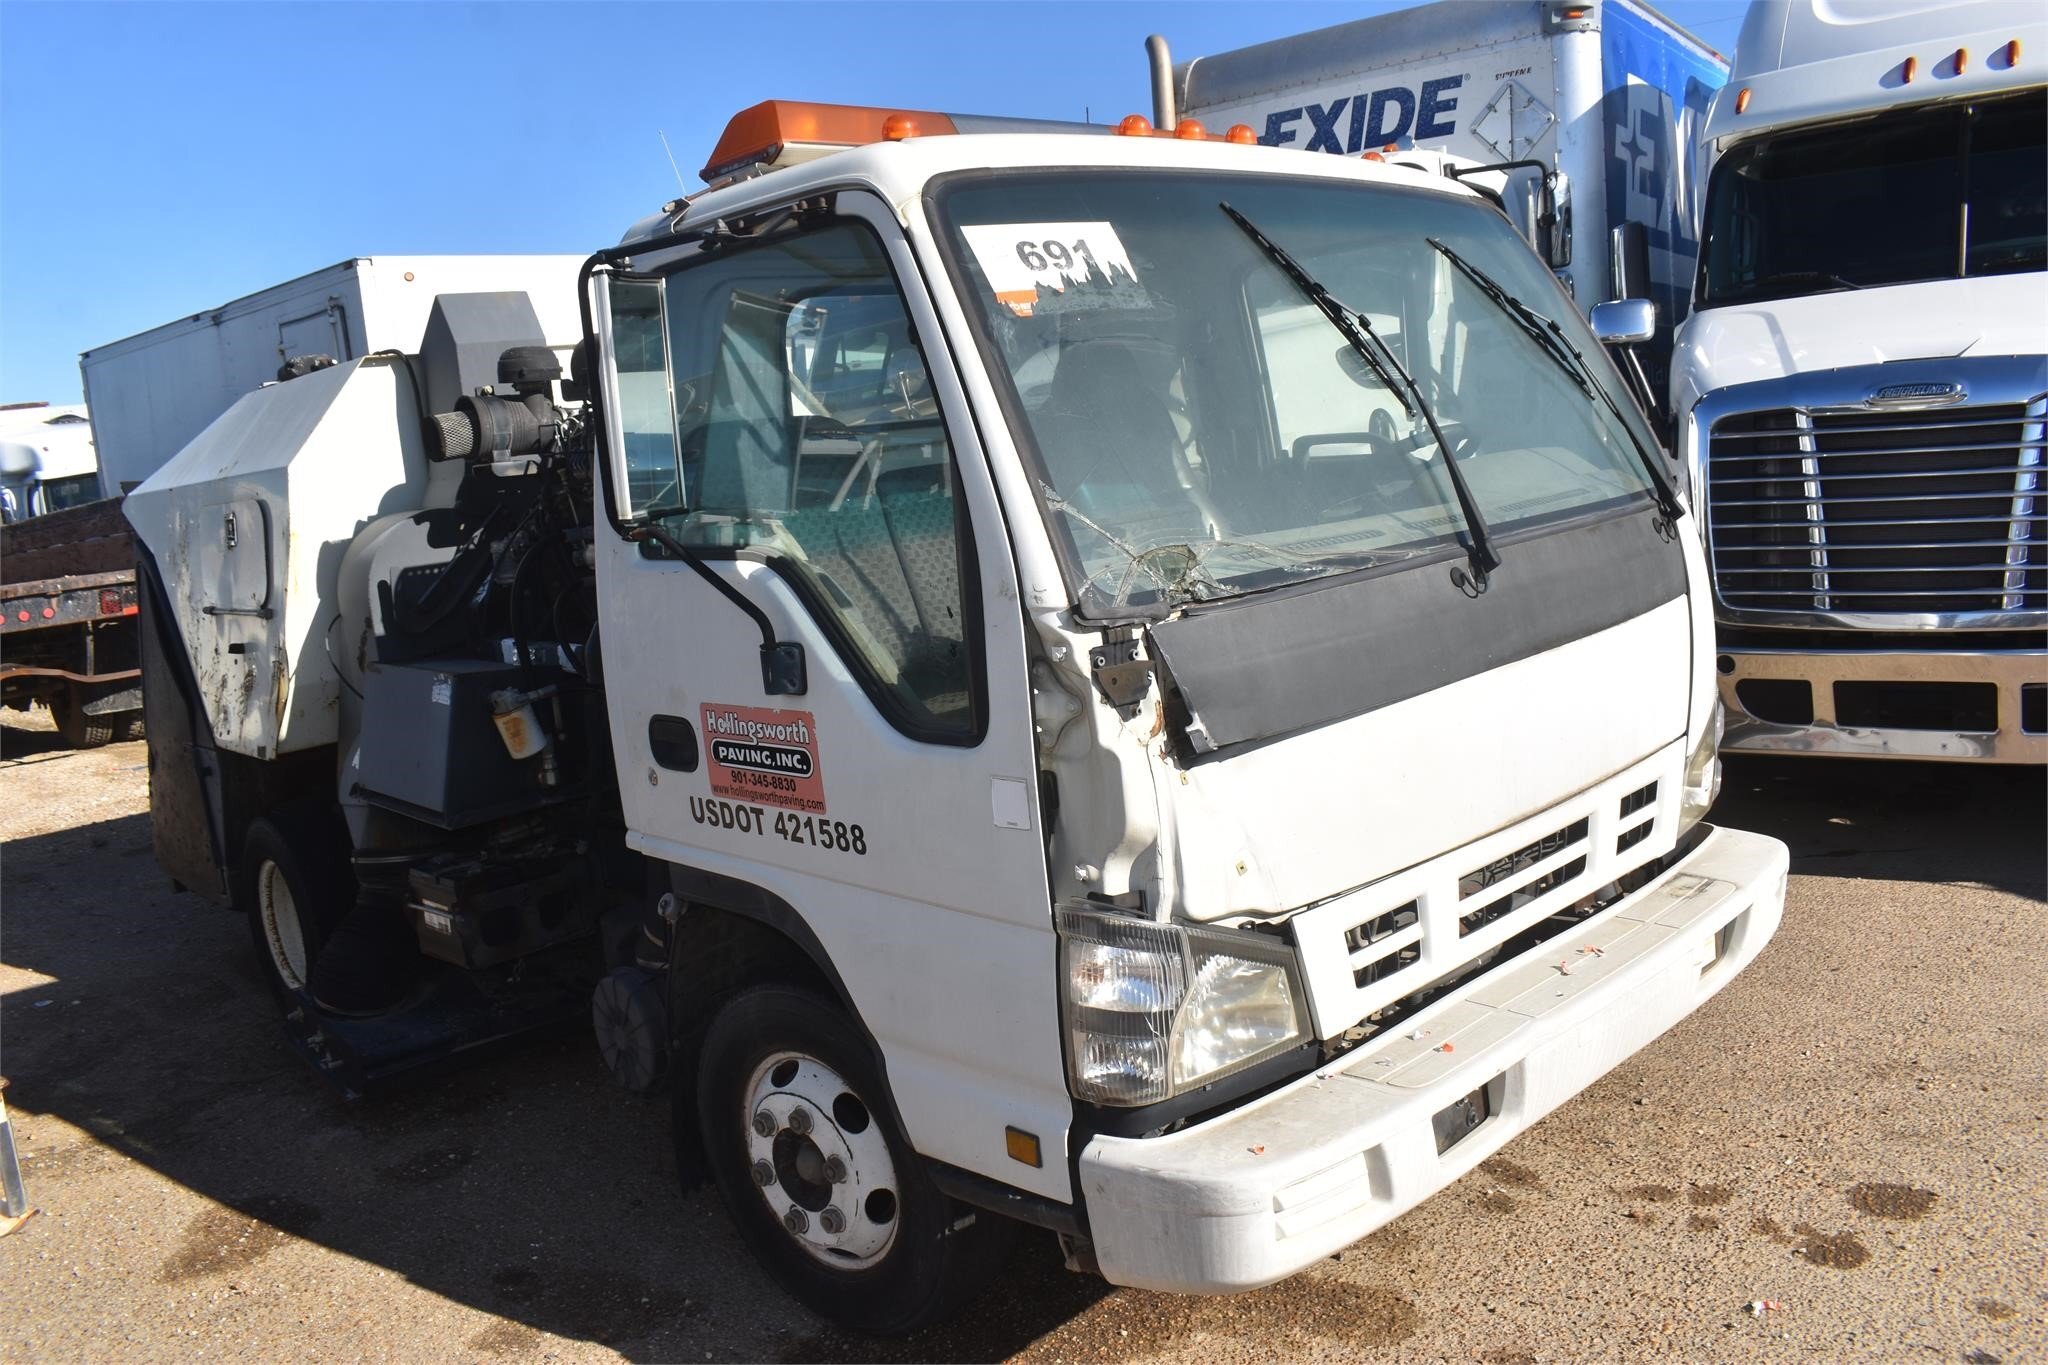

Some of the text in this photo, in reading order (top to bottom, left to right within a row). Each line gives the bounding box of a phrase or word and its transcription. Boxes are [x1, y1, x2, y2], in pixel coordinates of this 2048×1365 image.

[1257, 74, 1463, 155] EXIDE
[1016, 239, 1096, 272] 691
[706, 709, 811, 746] Hollingsworth
[731, 770, 797, 792] 901-345-8830
[689, 795, 867, 855] USDOT 421588
